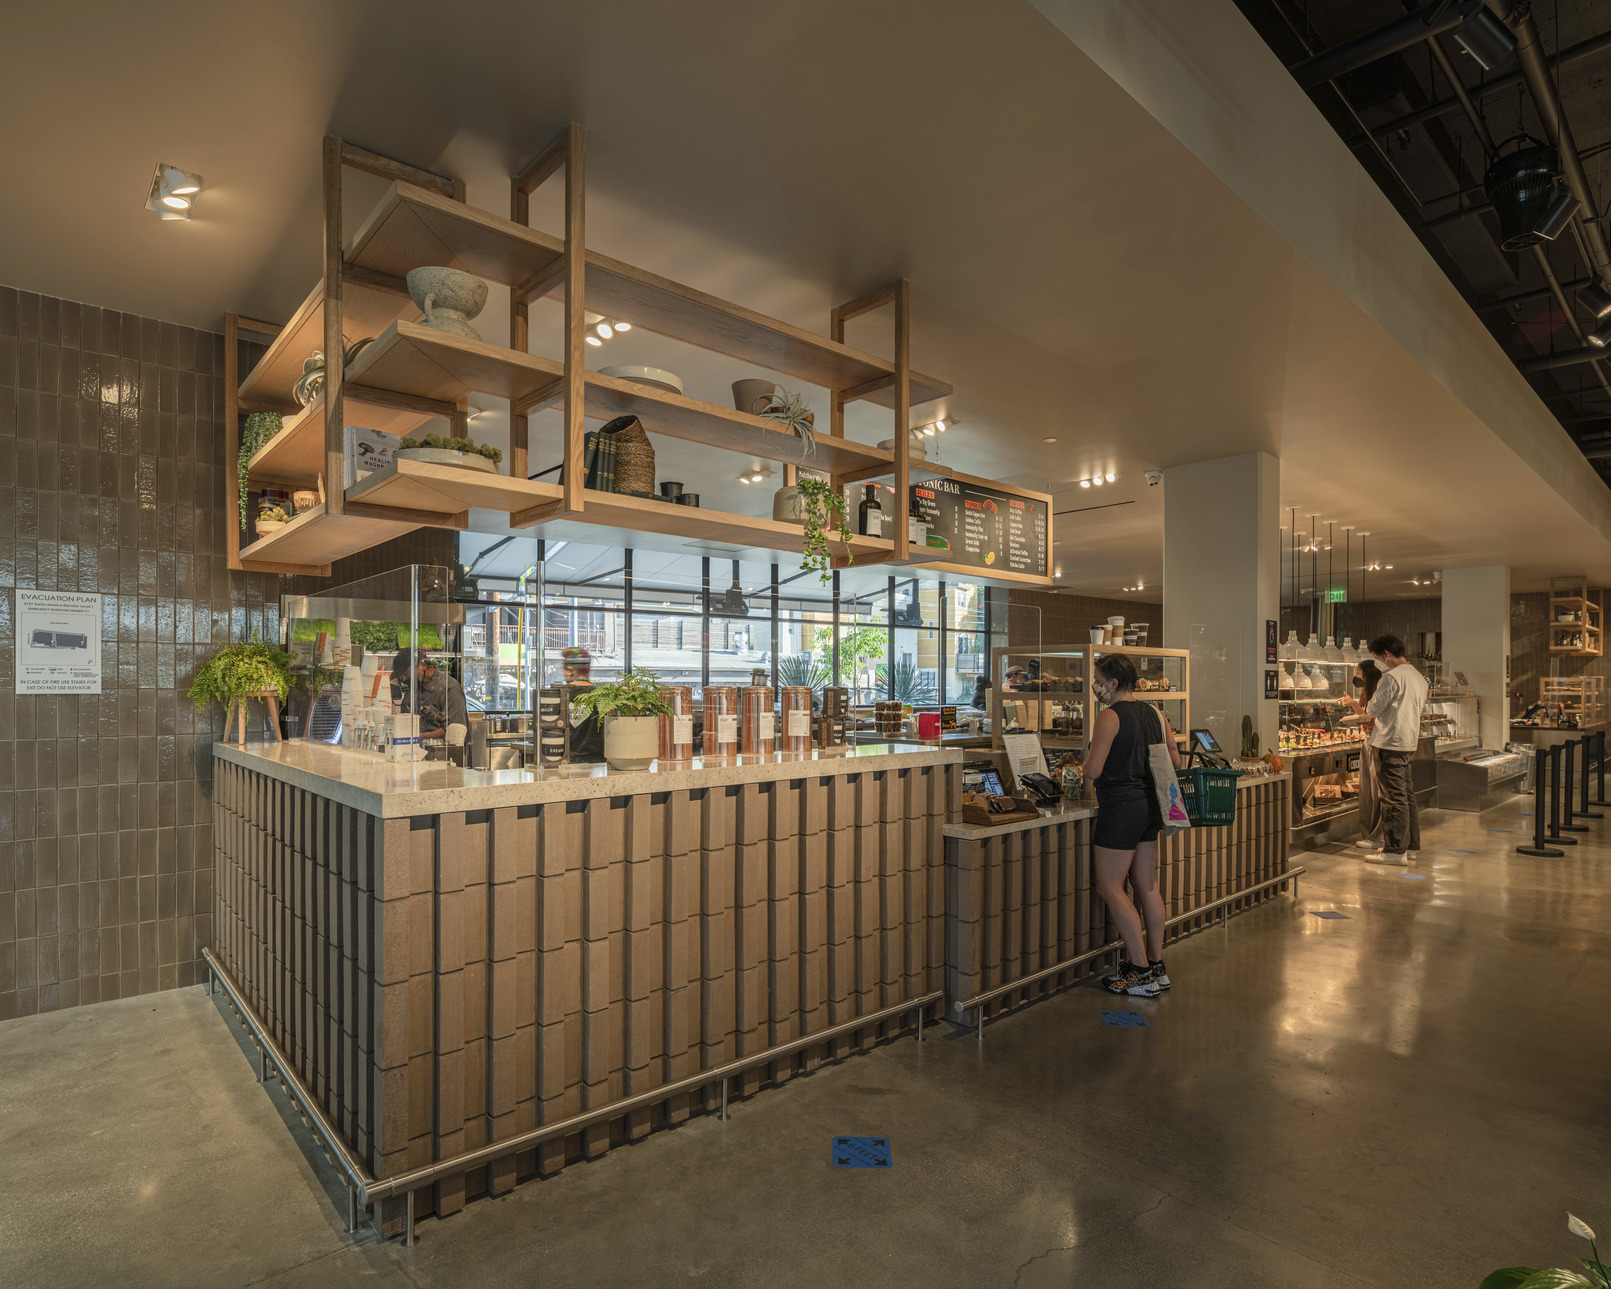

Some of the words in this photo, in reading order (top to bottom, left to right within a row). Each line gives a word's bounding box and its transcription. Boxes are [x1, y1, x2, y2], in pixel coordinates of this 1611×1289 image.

[917, 489, 934, 498] JUICES
[943, 481, 960, 495] BAR
[21, 593, 75, 602] EVACUATION
[1329, 590, 1345, 602] EXIT
[854, 1146, 879, 1160] FEET
